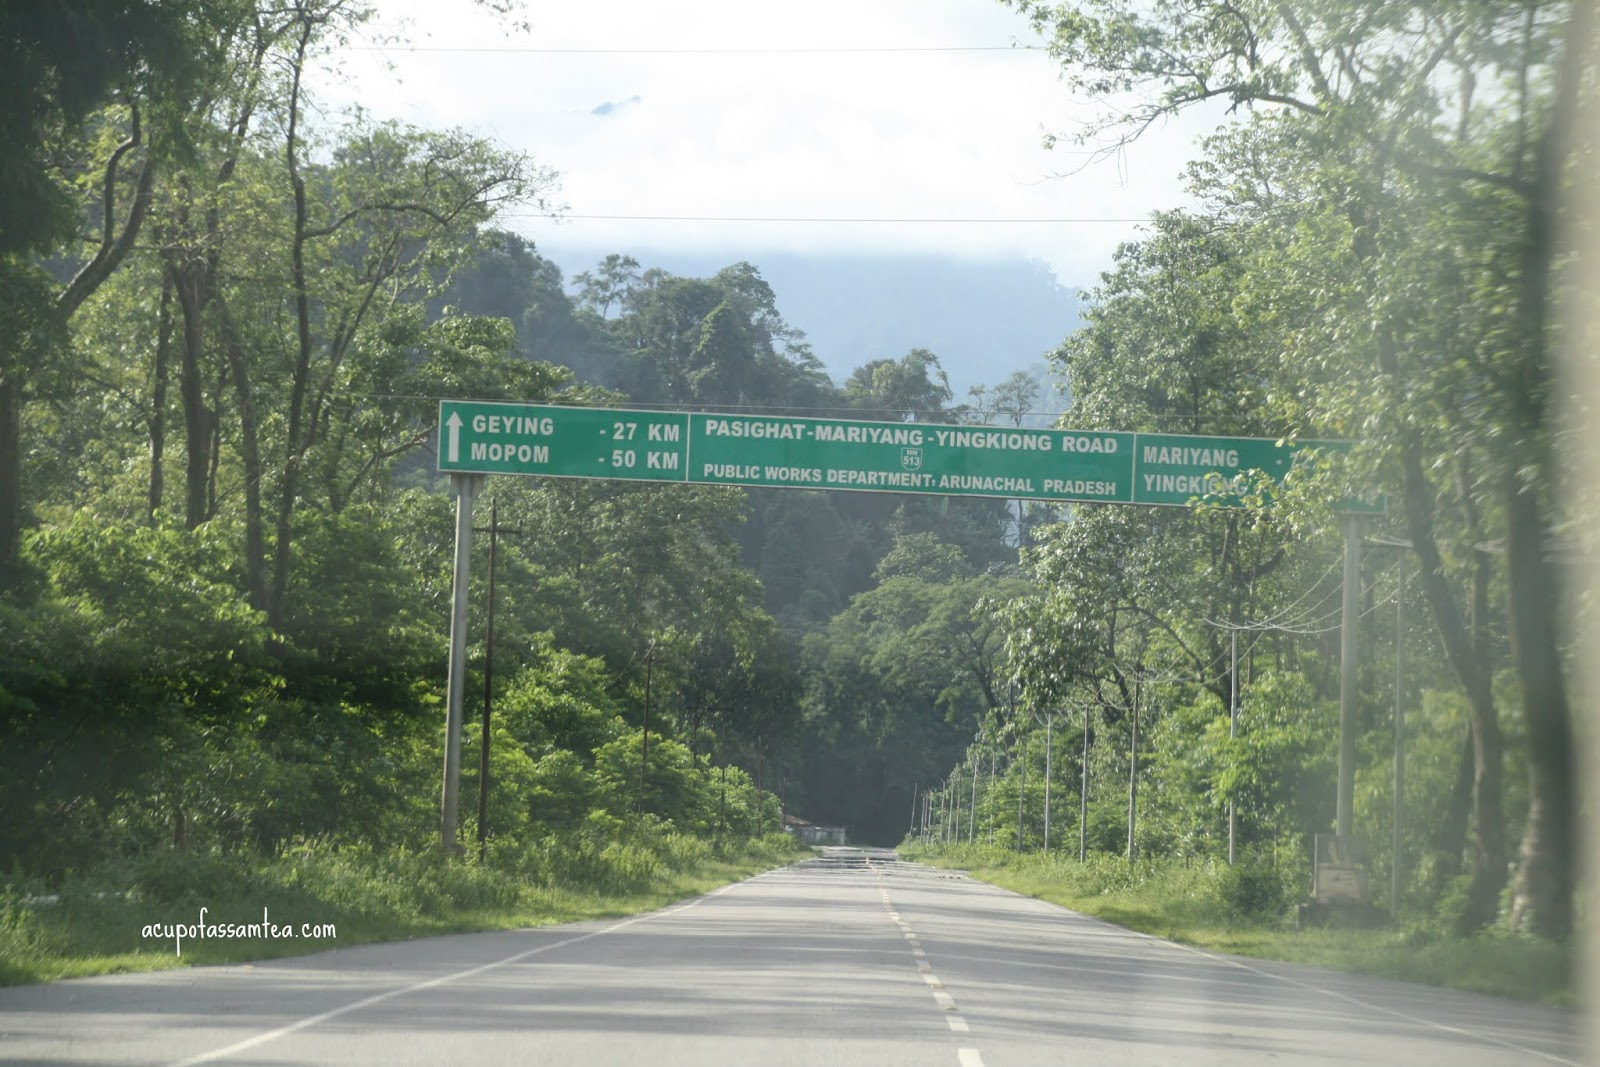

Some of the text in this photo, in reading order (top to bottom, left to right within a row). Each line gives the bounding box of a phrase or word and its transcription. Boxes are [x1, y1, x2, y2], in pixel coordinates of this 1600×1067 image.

[472, 414, 554, 436] GEYING
[648, 423, 680, 442] KM
[471, 442, 549, 464] MOPOM
[647, 451, 679, 470] KM
[1062, 436, 1118, 454] ROAD
[1143, 445, 1239, 467] MARIYANG
[903, 456, 920, 466] 513
[703, 463, 761, 479] PUBLIC
[765, 466, 822, 482] WORKS
[939, 474, 1035, 493] ARUNACHAL
[1043, 479, 1117, 496] PRADESH
